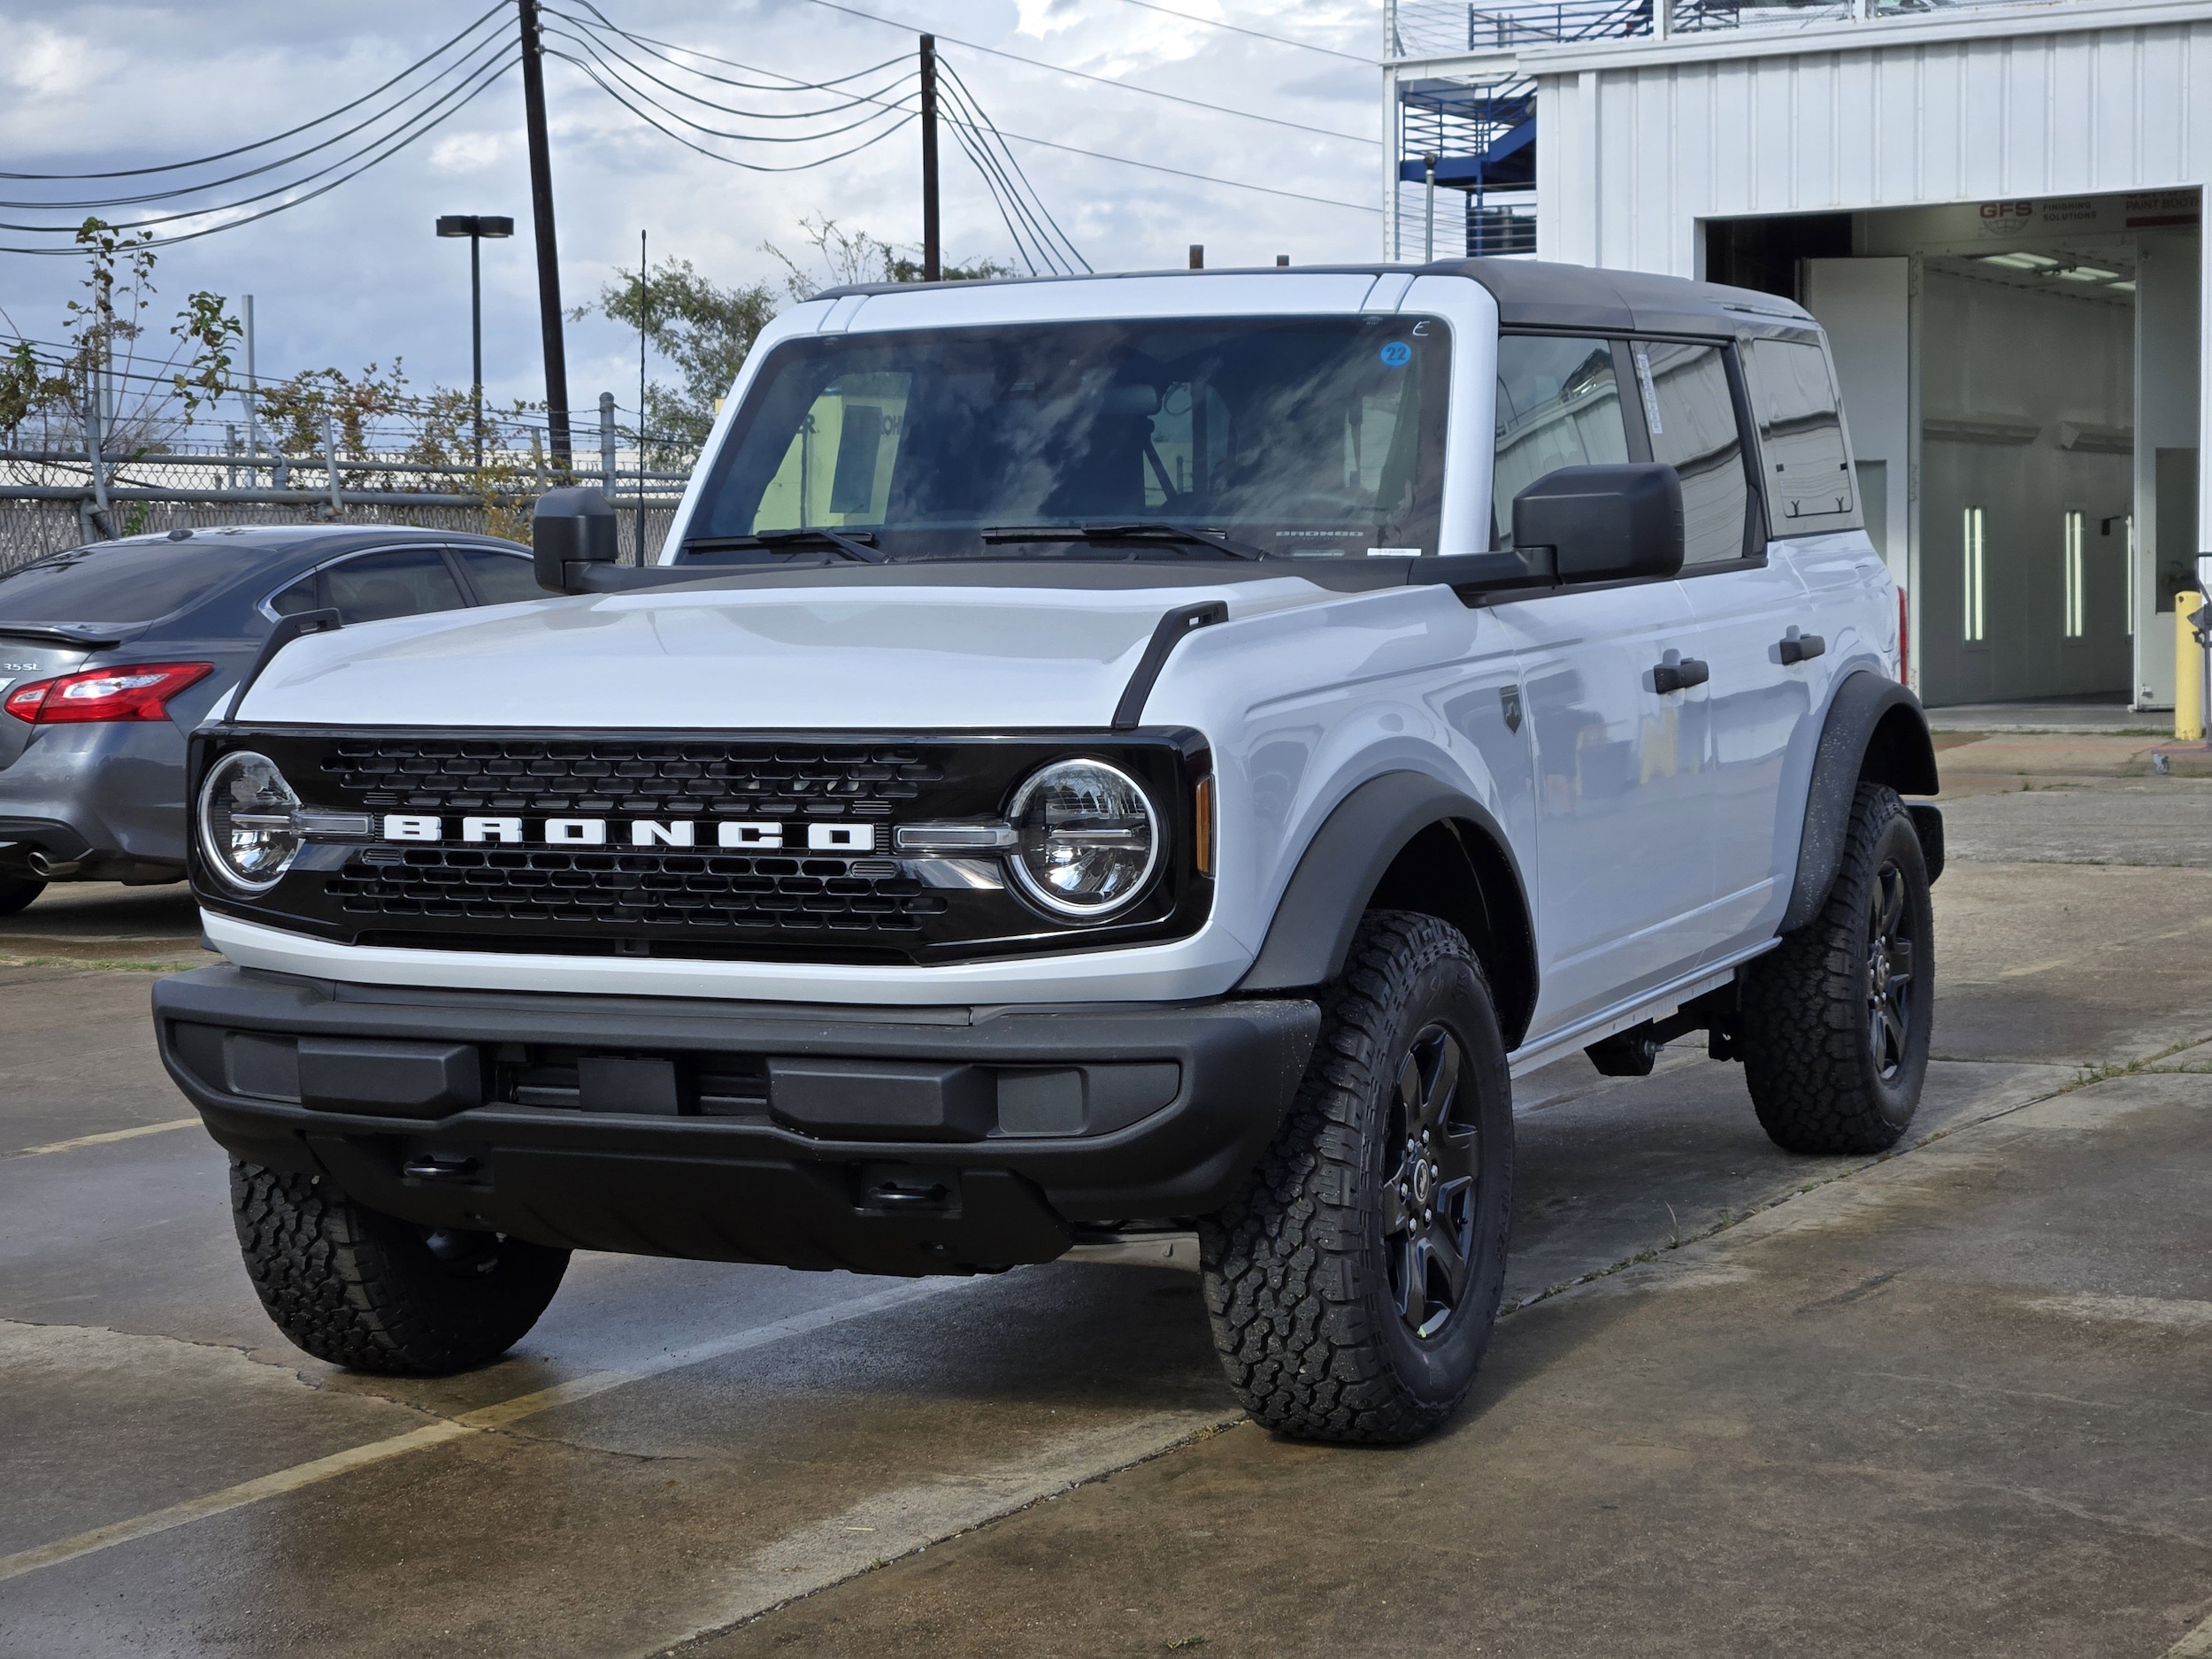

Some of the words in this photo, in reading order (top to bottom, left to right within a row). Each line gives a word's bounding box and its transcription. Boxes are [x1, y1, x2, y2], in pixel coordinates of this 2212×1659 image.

[1979, 201, 2033, 219] GFS
[2042, 202, 2092, 211] FINISHING
[2125, 197, 2159, 211] PAINT
[2042, 210, 2097, 221] SOLUTIONS
[1386, 346, 1408, 361] 22
[383, 814, 876, 850] BRONCO
